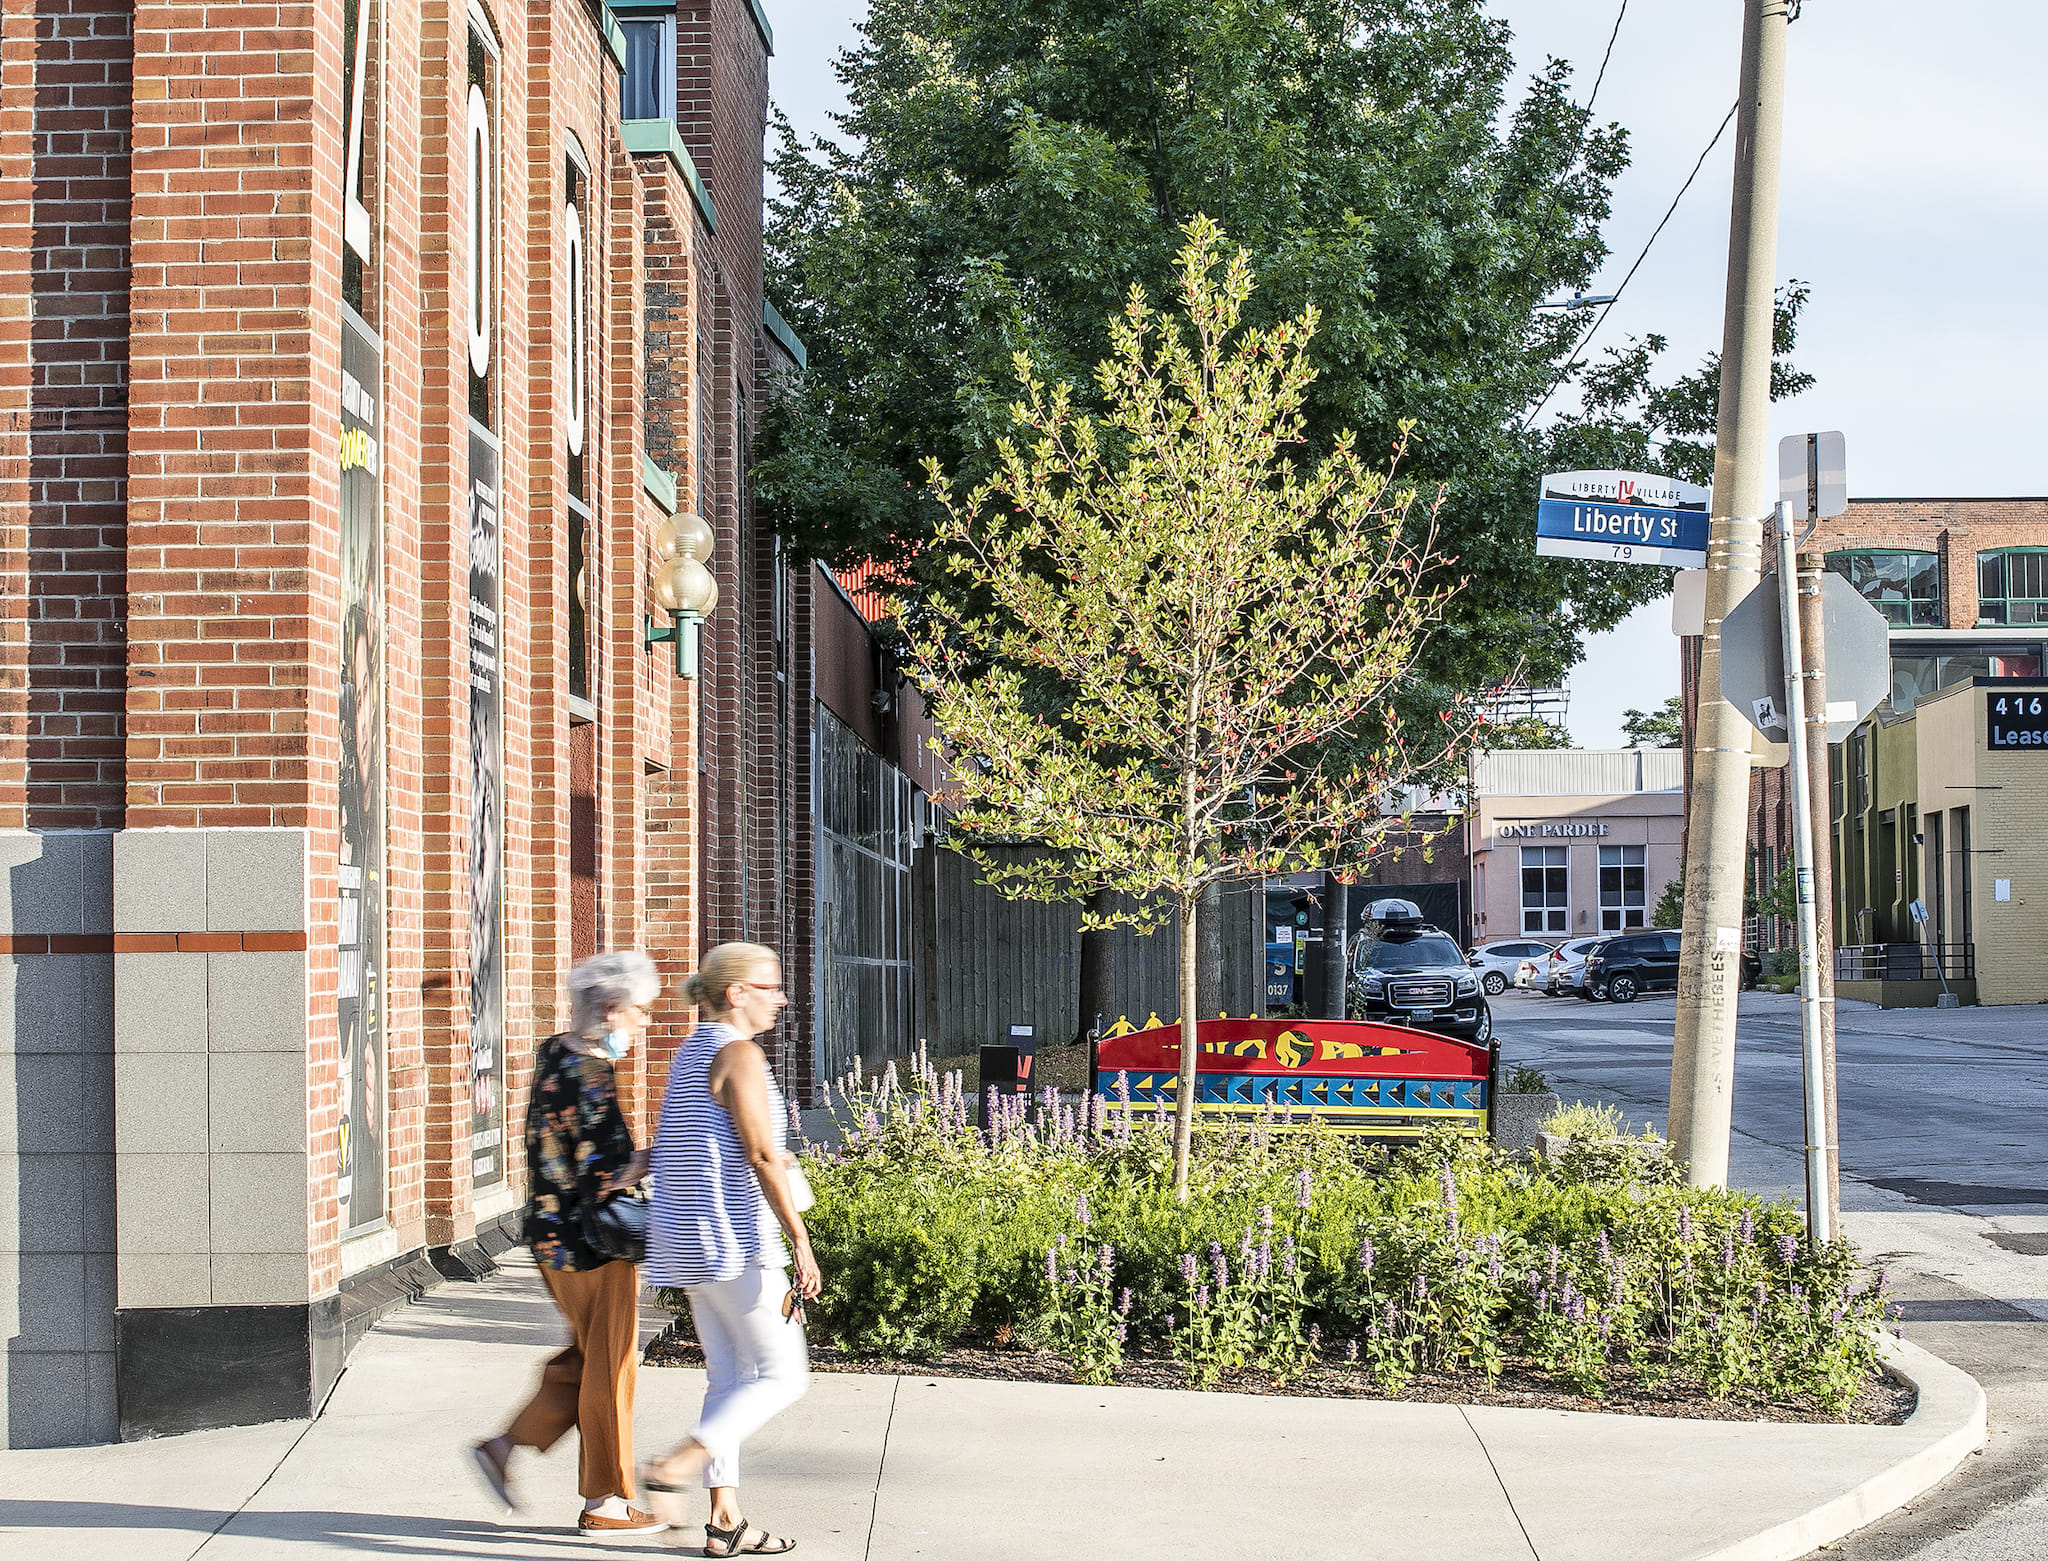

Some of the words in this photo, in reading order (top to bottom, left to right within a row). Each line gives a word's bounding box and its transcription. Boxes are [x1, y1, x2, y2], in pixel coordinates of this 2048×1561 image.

[1572, 482, 1617, 495] LIBERTY
[1636, 487, 1681, 500] VILLAGE
[1573, 506, 1655, 543] Liberty
[1659, 516, 1679, 538] St
[1612, 545, 1633, 559] 79
[1499, 824, 1538, 838] ONE
[1540, 823, 1609, 837] PARDEE
[1267, 984, 1289, 996] 0137
